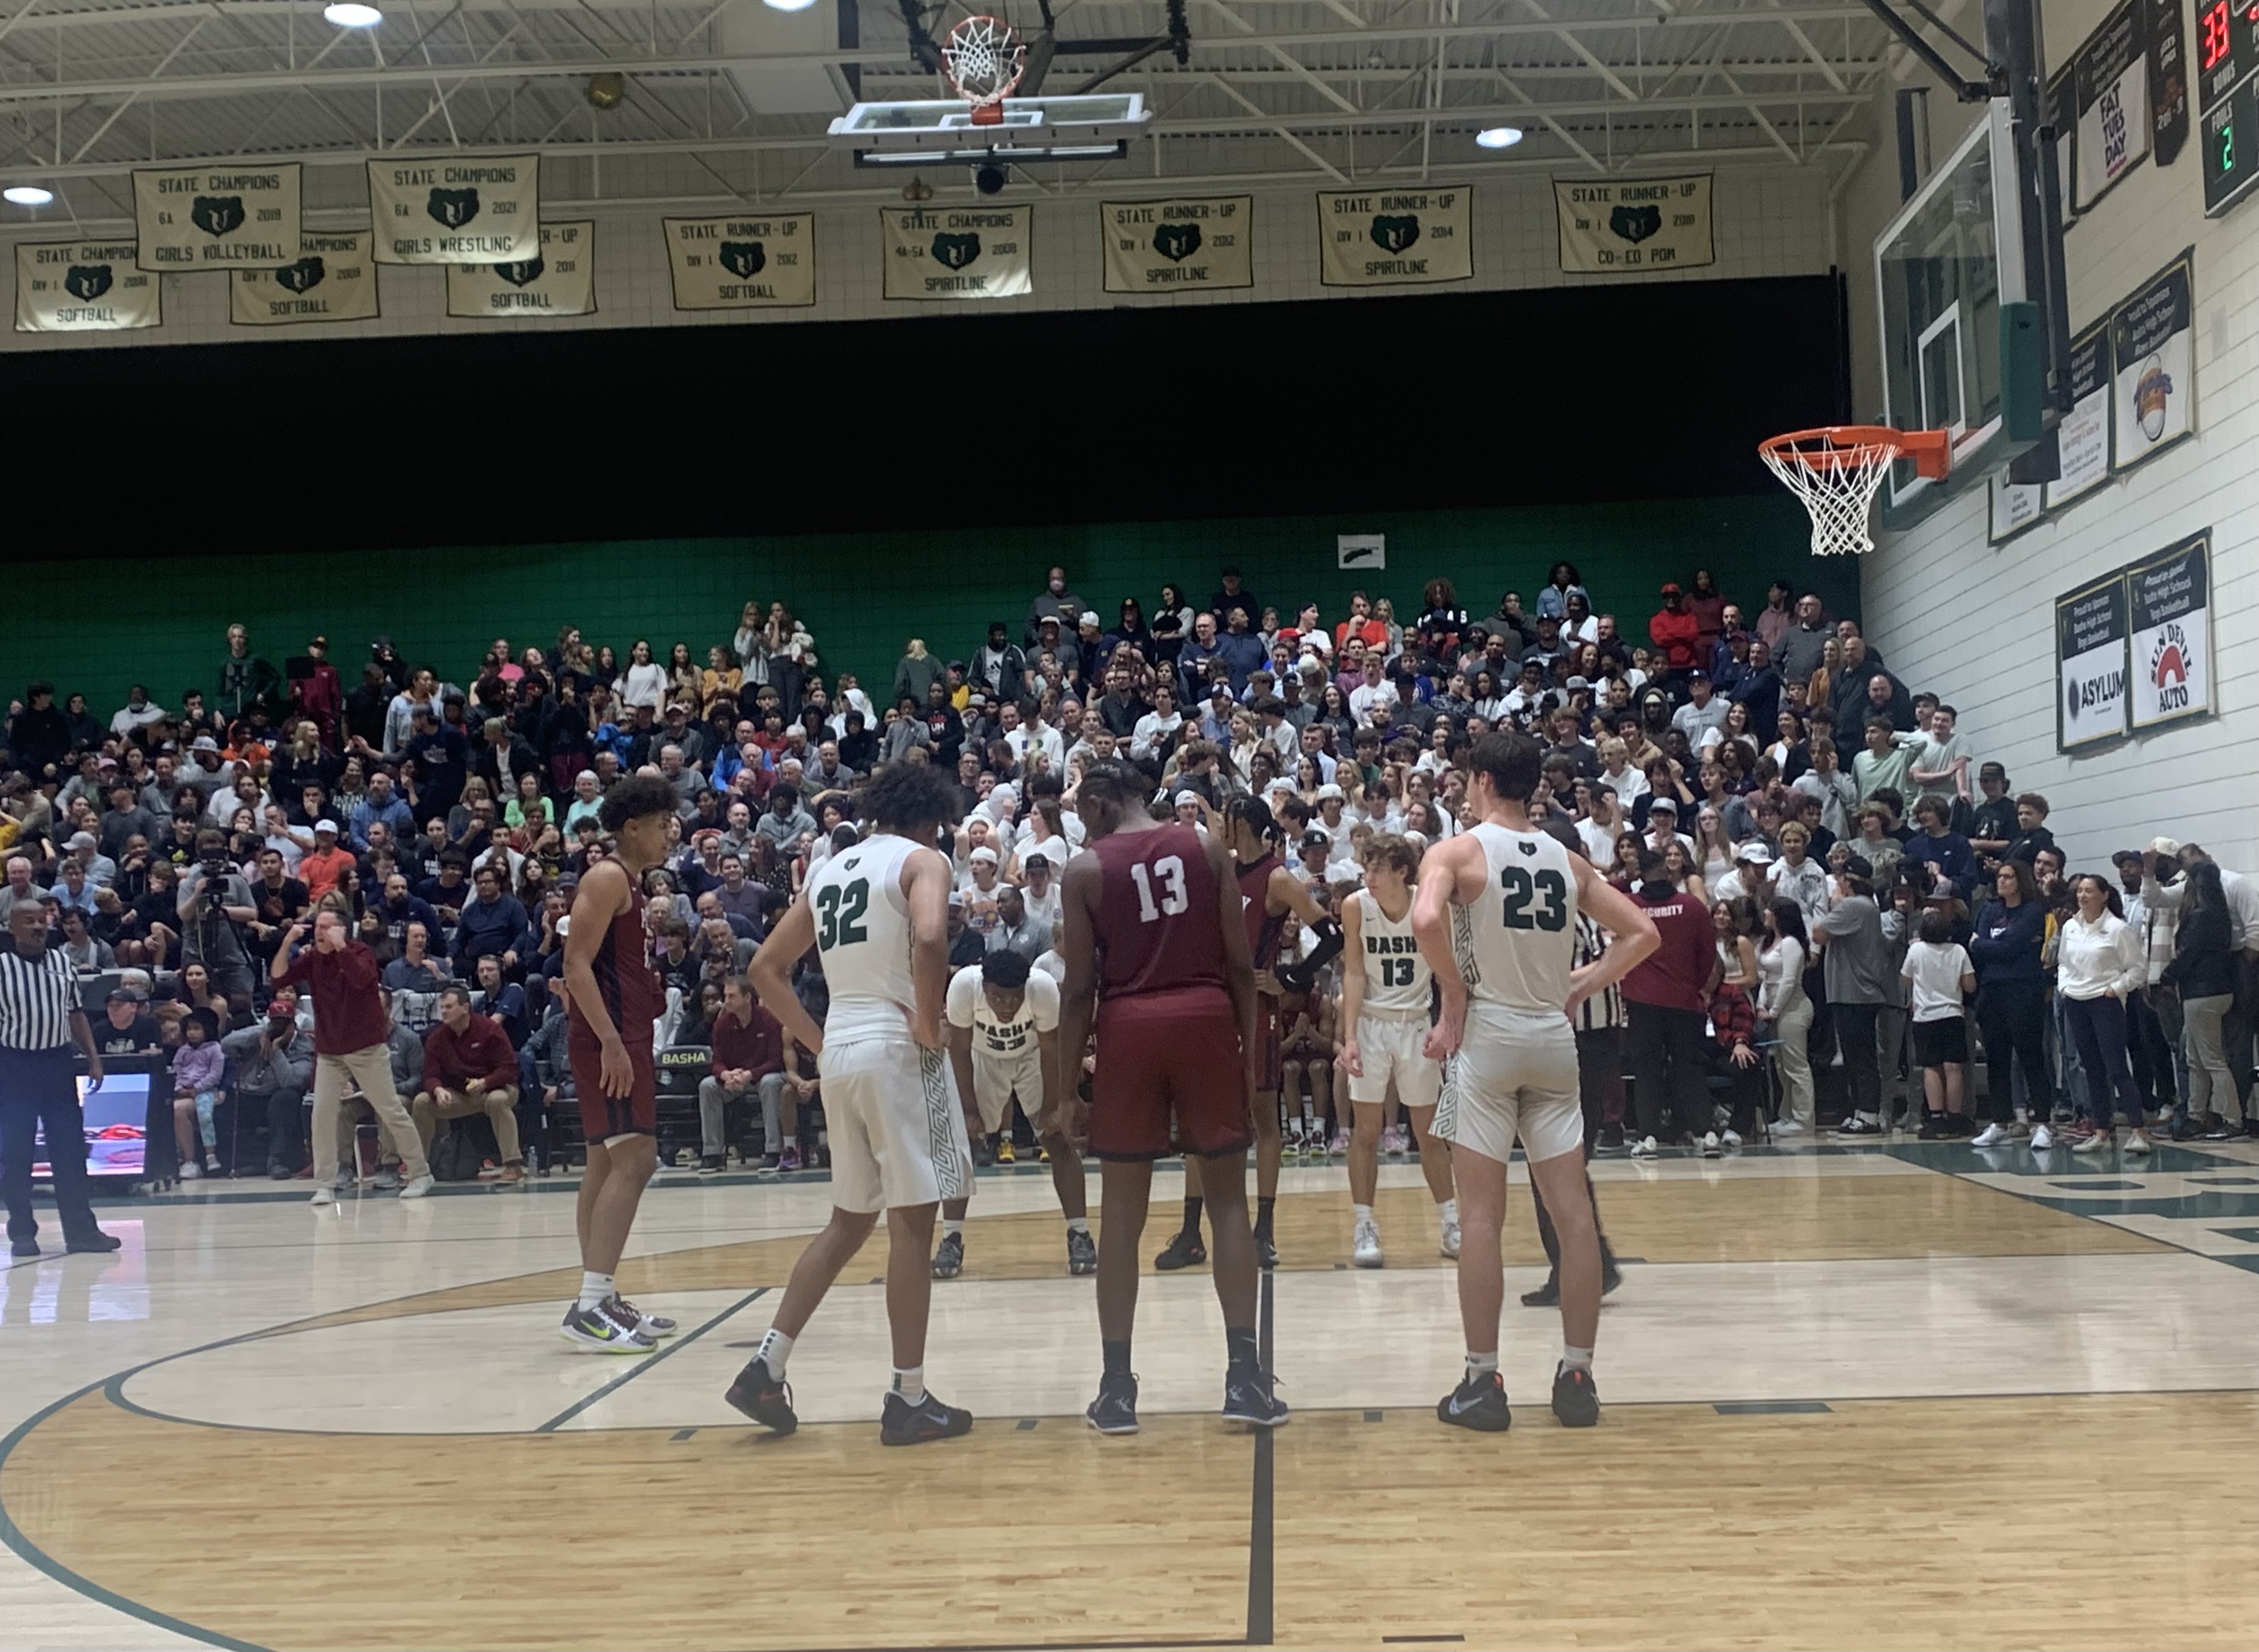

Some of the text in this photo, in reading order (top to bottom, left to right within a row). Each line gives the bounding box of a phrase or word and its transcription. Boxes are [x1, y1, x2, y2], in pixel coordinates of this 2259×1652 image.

[2203, 0, 2228, 68] 33
[2100, 80, 2121, 123] FAT
[2103, 108, 2124, 144] TUES
[2105, 130, 2126, 168] DAY
[2222, 126, 2232, 170] 2
[159, 174, 279, 193] STATE CHAMPIONS
[394, 167, 516, 186] STATE CHAMPIONS
[1572, 187, 1611, 202] STATE
[395, 204, 409, 216] 6A
[492, 201, 517, 214] 2021
[1334, 198, 1372, 213] STATE
[159, 212, 173, 225] 6A
[902, 214, 1013, 230] STATE CHAMPIONS
[1117, 208, 1156, 223] STATE
[680, 223, 718, 240] STATE
[1431, 226, 1453, 238] 2014
[1576, 219, 1589, 230] DIV
[1337, 230, 1351, 242] DIV
[300, 238, 357, 252] HAMPIONS
[394, 236, 512, 255] GIRLS WRESTLING
[1120, 239, 1134, 251] DIV
[36, 246, 137, 264] STATE CHAMPION
[156, 244, 286, 262] GIRLS VOLLEYBALL
[777, 253, 797, 266] 2012
[1651, 248, 1675, 262] POM
[686, 255, 701, 267] DIV
[1366, 259, 1428, 276] SPIRITLINE
[1146, 267, 1209, 283] SPIRITLINE
[32, 279, 47, 291] DIV
[925, 276, 987, 291] SPIRITLINE
[719, 284, 777, 299] SOFTBALL
[269, 300, 331, 315] SOFTBALL
[491, 293, 552, 308] SOFTBALL
[57, 307, 116, 322] SOFTBALL
[2081, 669, 2124, 708] ASYLUM
[2159, 685, 2188, 712] AUTO
[1131, 855, 1189, 922] 13
[1501, 866, 1566, 932] 23
[817, 877, 869, 952] 32
[1642, 904, 1683, 918] ECURITY
[1366, 936, 1418, 954] BASH
[1381, 958, 1415, 987] 13
[662, 1051, 705, 1064] BASHA
